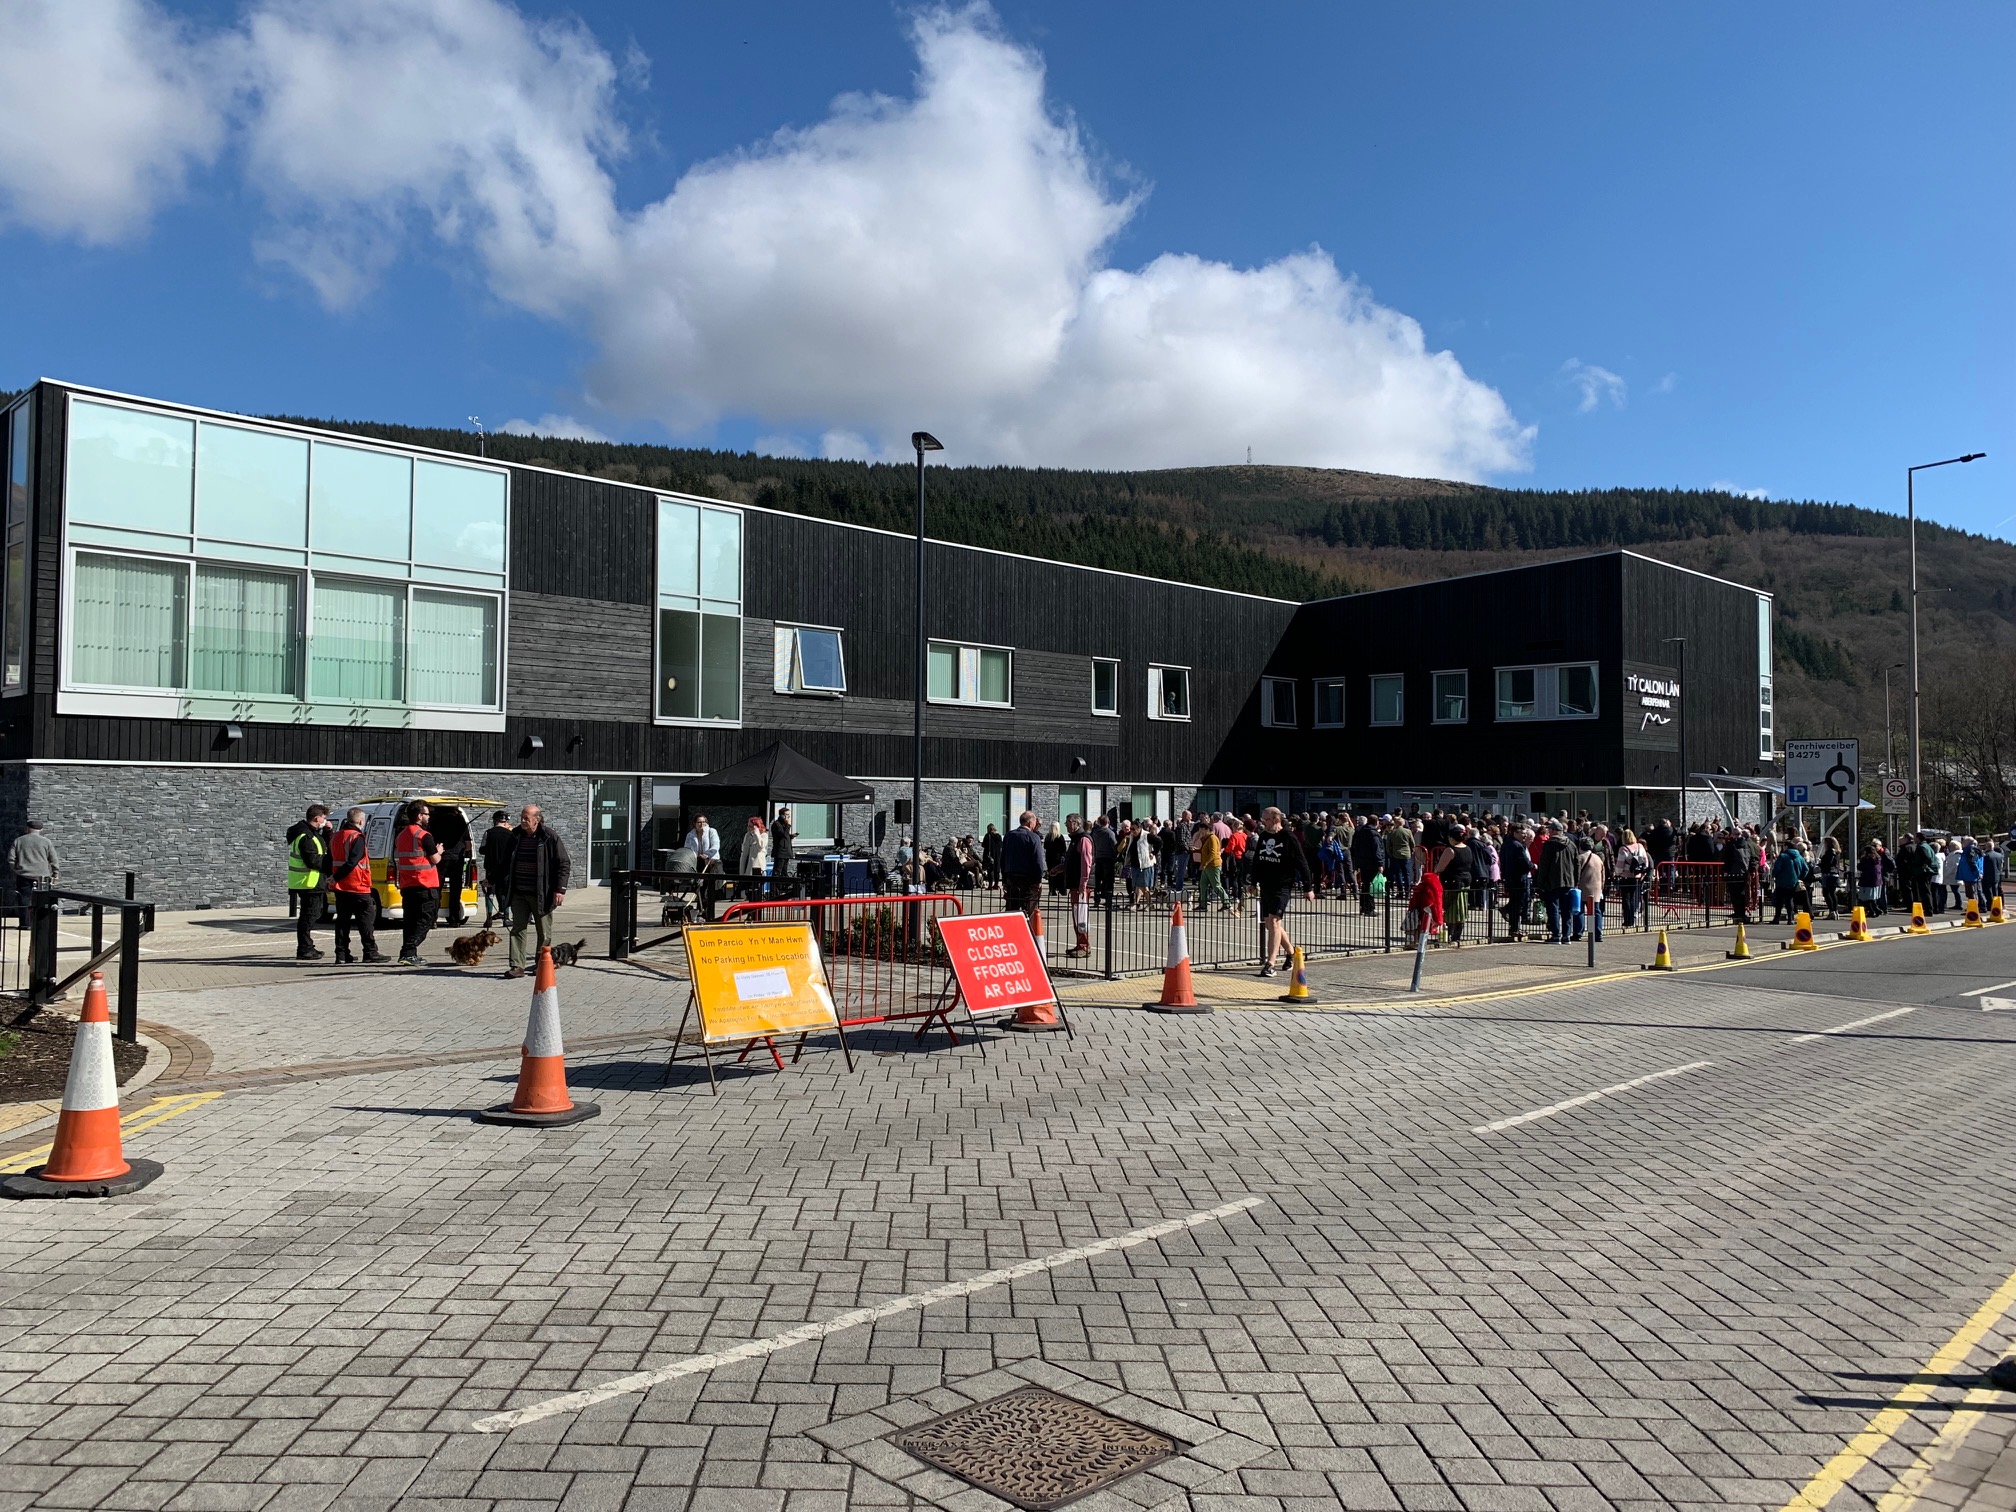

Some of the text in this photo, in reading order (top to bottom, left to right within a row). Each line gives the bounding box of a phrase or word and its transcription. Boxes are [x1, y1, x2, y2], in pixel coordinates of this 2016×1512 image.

[1639, 678, 1665, 695] CALON
[1665, 680, 1680, 697] LÂN
[1788, 742, 1855, 751] Penrhiwceiber
[1793, 787, 1806, 801] P
[1889, 784, 1904, 793] 30
[967, 925, 1004, 942] ROAD
[699, 936, 804, 948] Dim Parcio Yn Y Man Hwn
[701, 952, 809, 965] No Parking In This Location
[967, 942, 1018, 962] CLOSED
[973, 960, 1025, 981] FFORDD
[984, 978, 1032, 999] AR GAU
